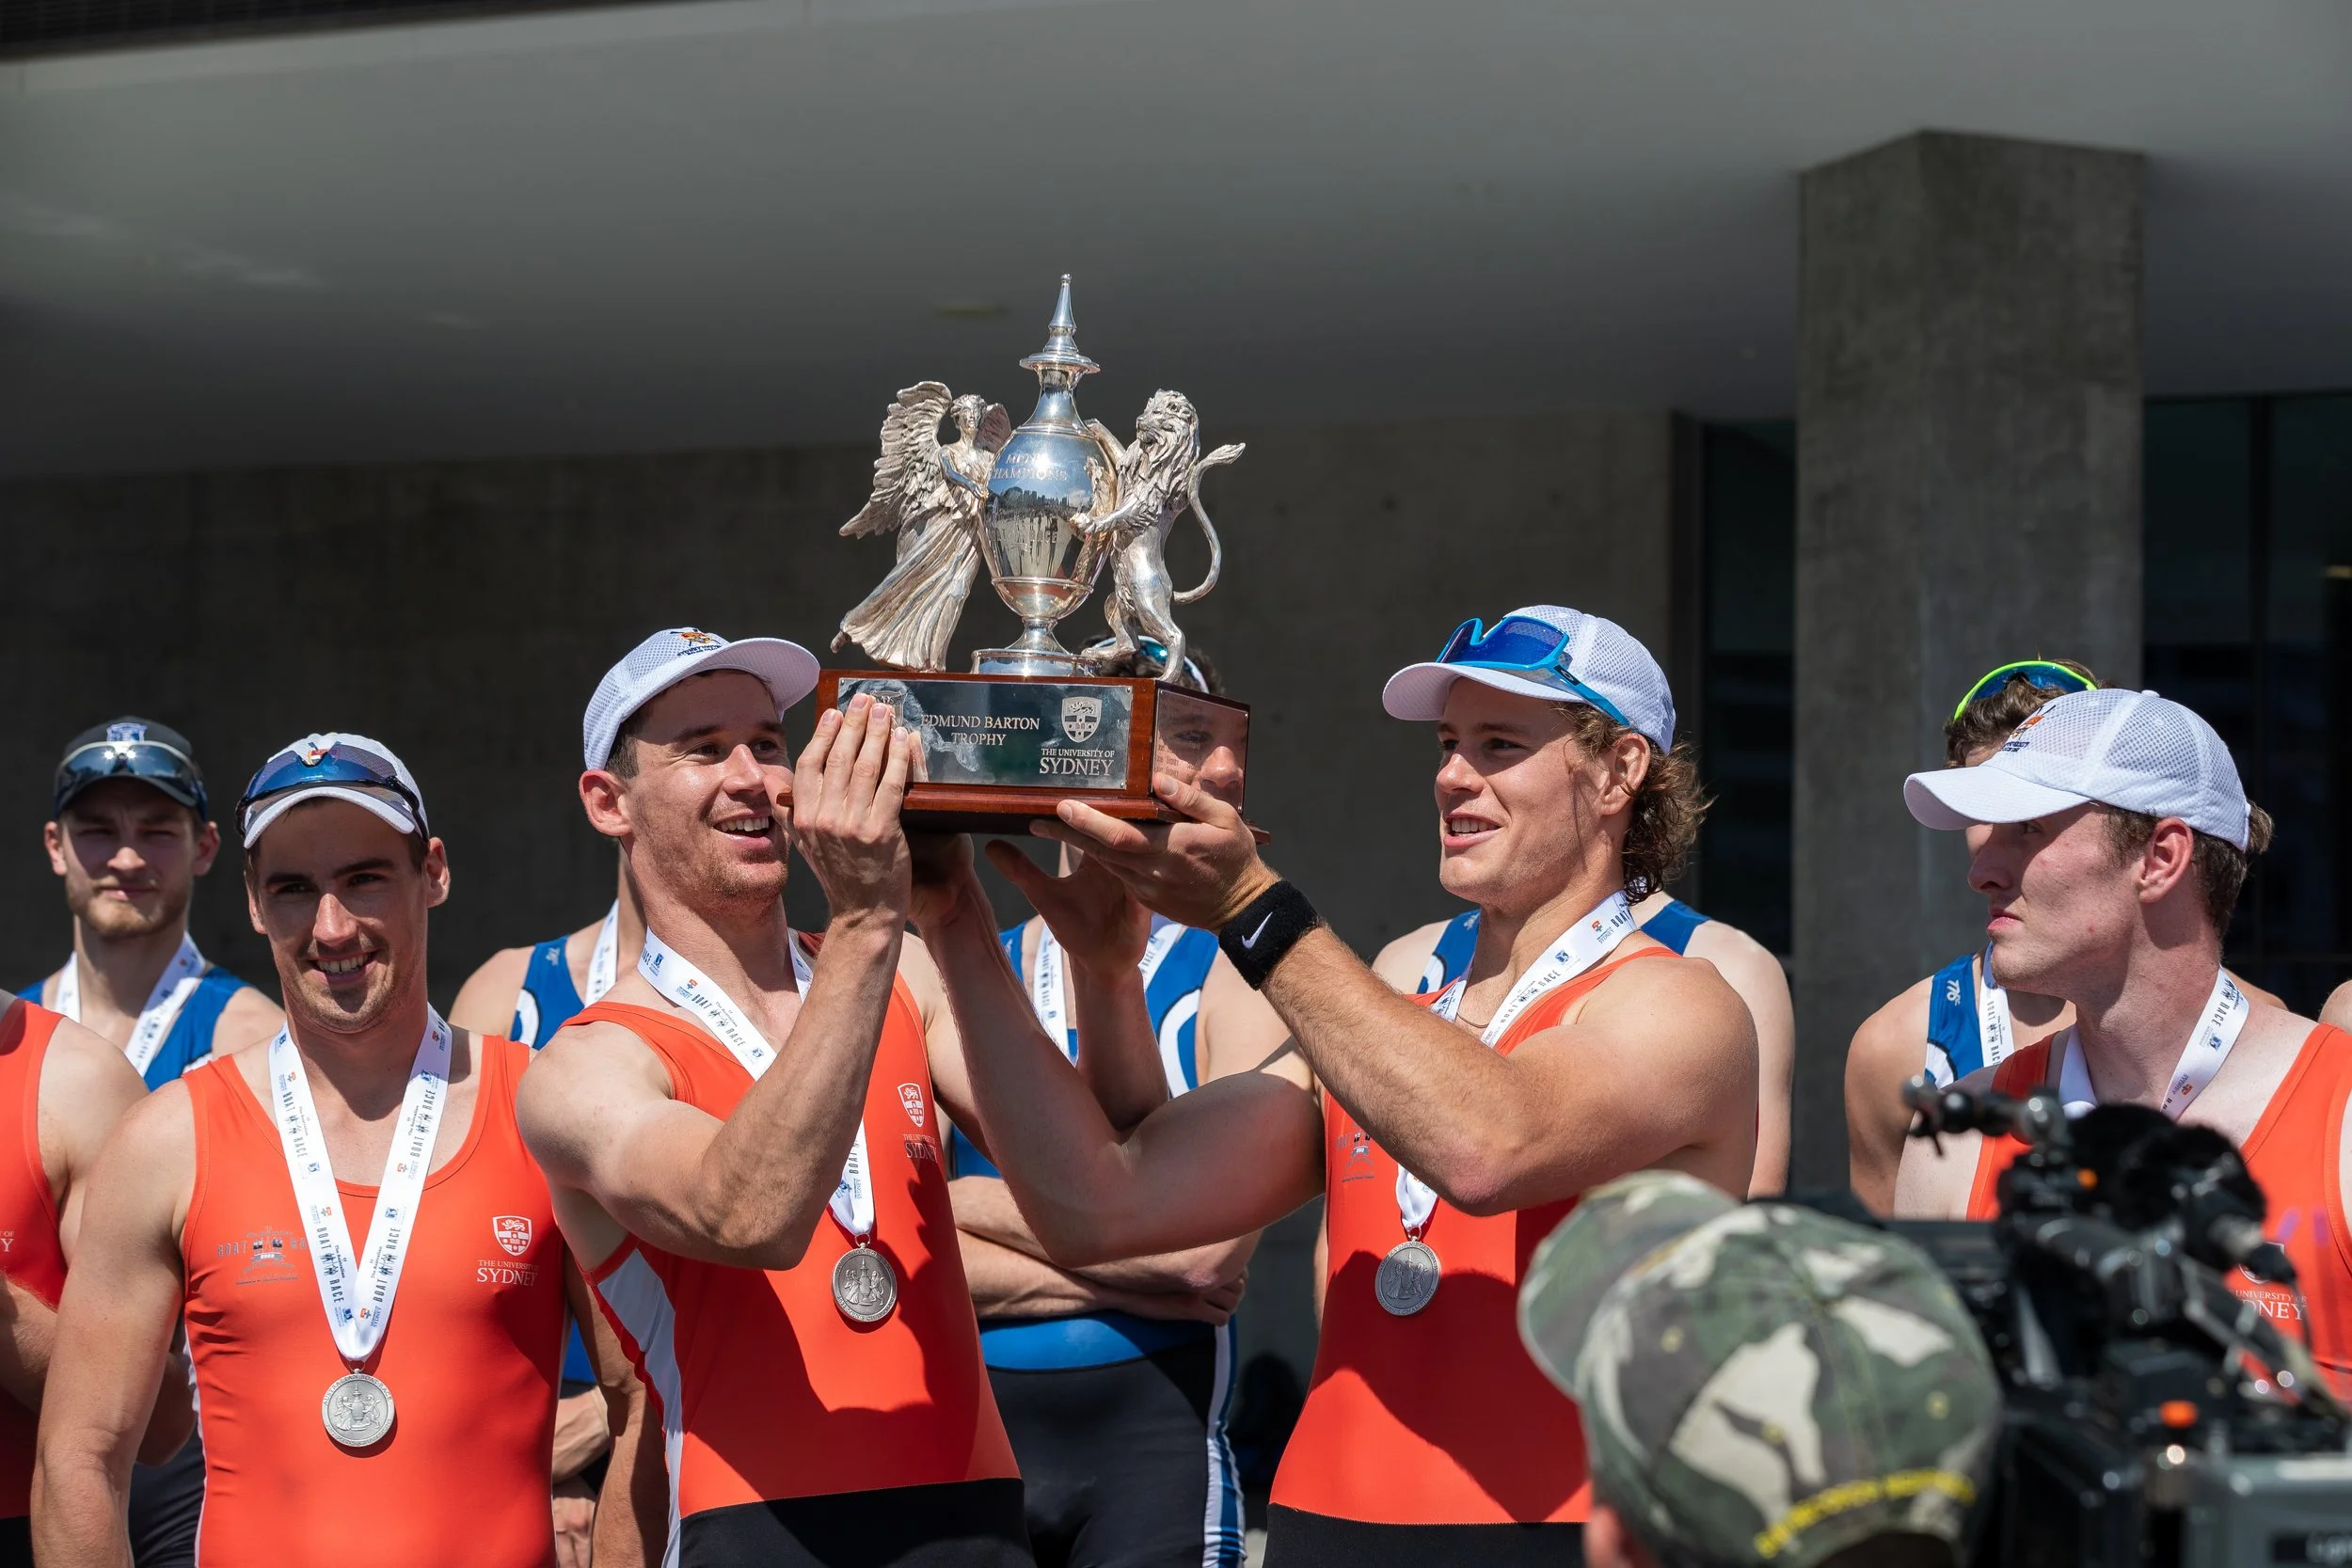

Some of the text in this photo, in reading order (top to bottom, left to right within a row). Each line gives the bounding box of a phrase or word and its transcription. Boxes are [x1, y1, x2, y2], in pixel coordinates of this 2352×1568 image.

[921, 714, 1040, 730] EDMUND BARTON
[951, 732, 1007, 746] TROPHY
[1041, 748, 1115, 758] THE UNIVERSITY OF
[1039, 756, 1115, 776] SYDNEY
[1611, 910, 1630, 927] BOAT
[1537, 970, 1561, 987] RACE
[691, 993, 746, 1047] BOAT RACE
[2212, 1001, 2231, 1027] RACE
[282, 1091, 295, 1112] BOAT
[293, 1137, 308, 1158] RACE
[409, 1135, 424, 1158] BOAT
[421, 1089, 437, 1111] RACE
[217, 1241, 247, 1258] BOAT
[316, 1227, 332, 1249] BOAT
[329, 1278, 344, 1303] RACE
[373, 1227, 402, 1303] BOAT RACE
[476, 1267, 538, 1287] SYDNEY
[2235, 1290, 2294, 1302] UNIVERSITY
[2242, 1299, 2307, 1321] DNEY
